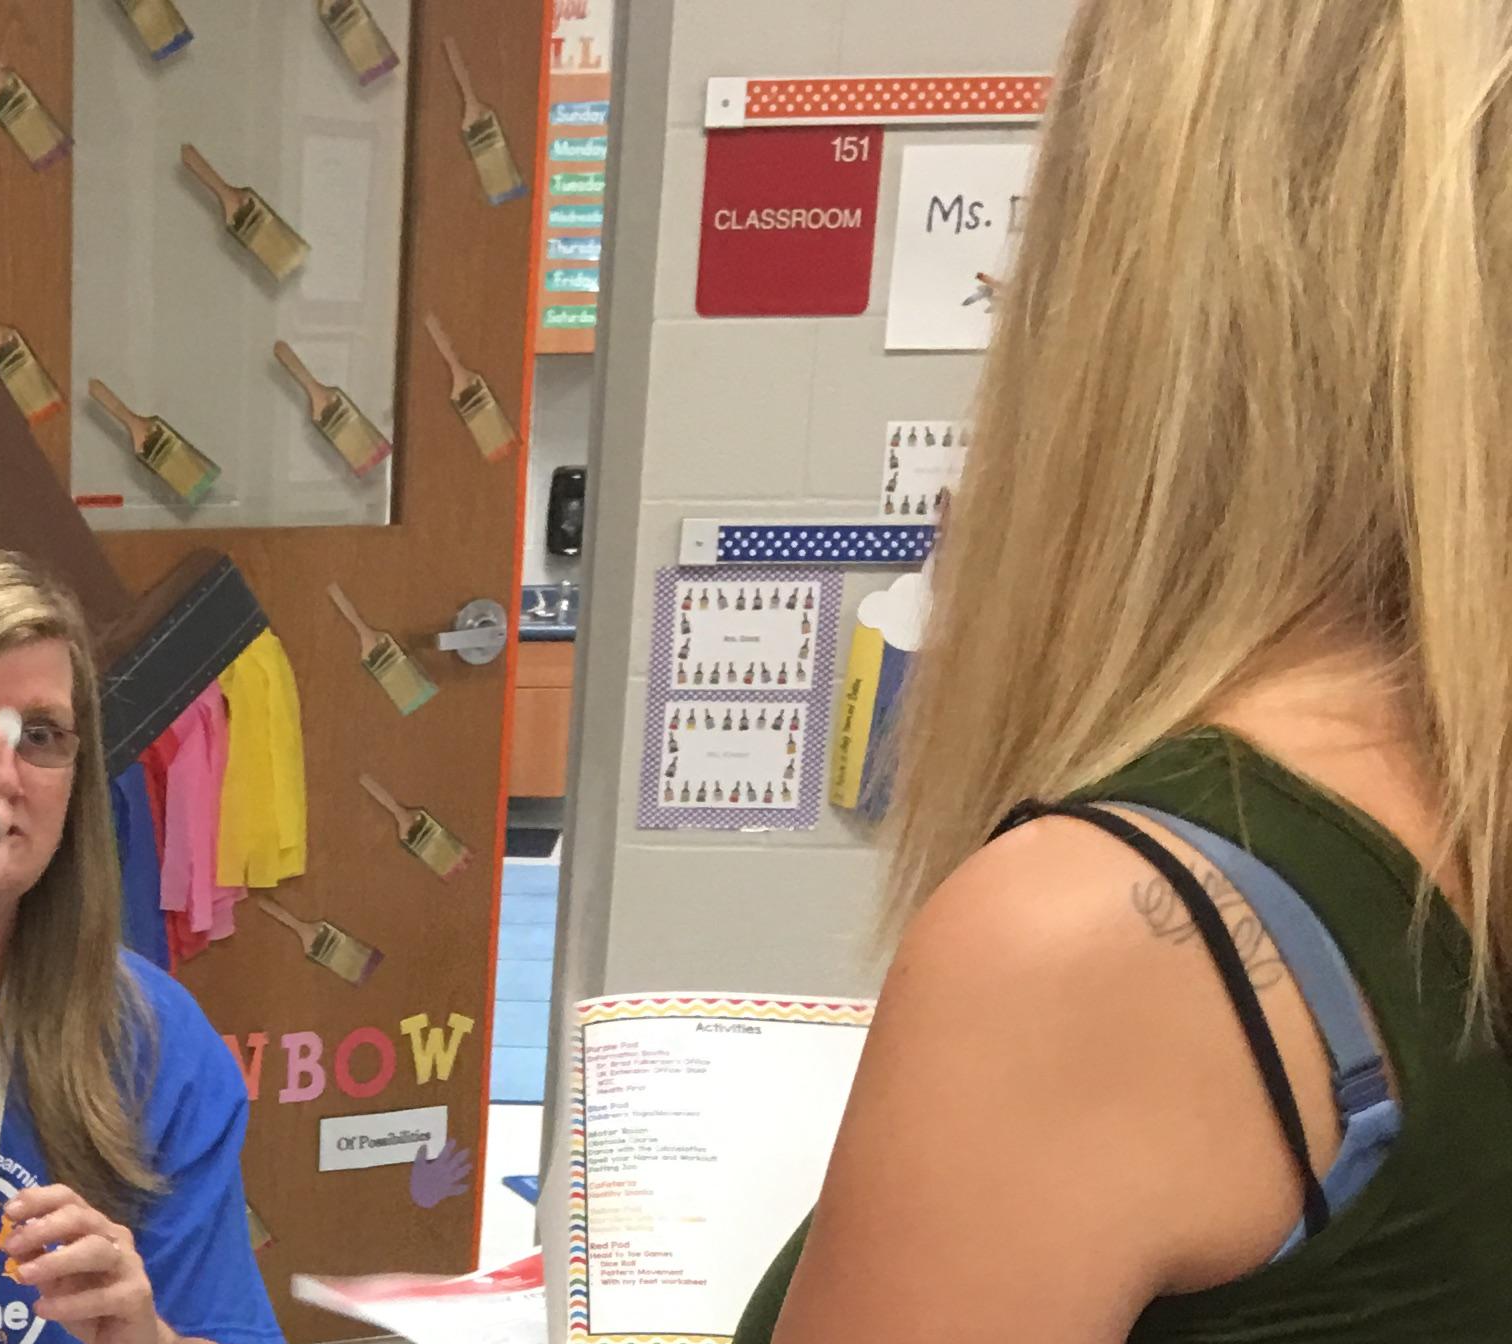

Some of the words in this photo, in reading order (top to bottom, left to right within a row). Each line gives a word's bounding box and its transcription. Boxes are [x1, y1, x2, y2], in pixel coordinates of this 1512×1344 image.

[831, 136, 870, 162] 151
[714, 208, 862, 230] CLASSROOM
[926, 194, 992, 235] Ms.
[696, 1023, 762, 1034] Activities
[337, 1135, 355, 1151] Of
[359, 1129, 432, 1150] Possibilities
